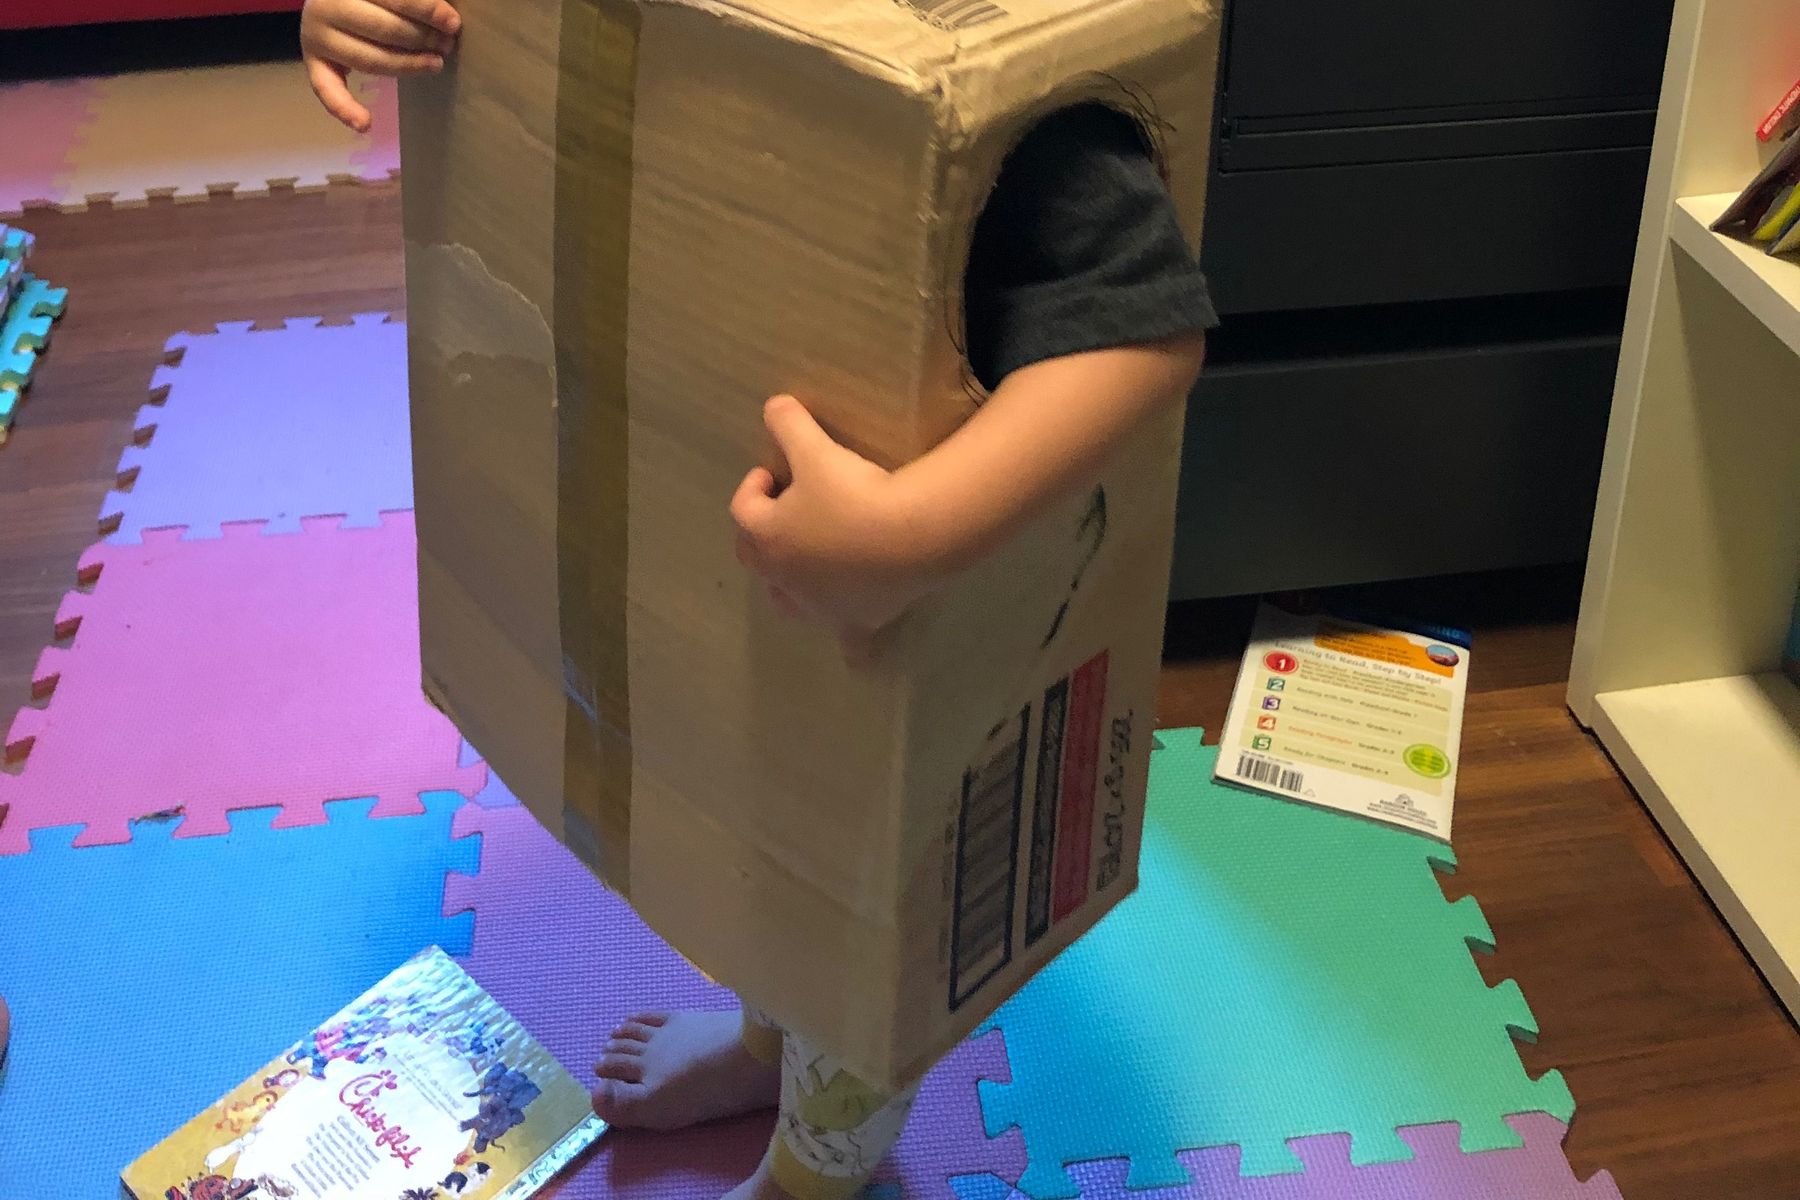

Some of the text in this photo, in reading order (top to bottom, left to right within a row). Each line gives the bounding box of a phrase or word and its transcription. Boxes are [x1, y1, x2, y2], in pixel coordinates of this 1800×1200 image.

[1279, 659, 1286, 668] 1
[1271, 679, 1283, 690] 2
[1267, 698, 1279, 709] 3
[1262, 717, 1274, 728] 4
[1258, 736, 1270, 748] 5
